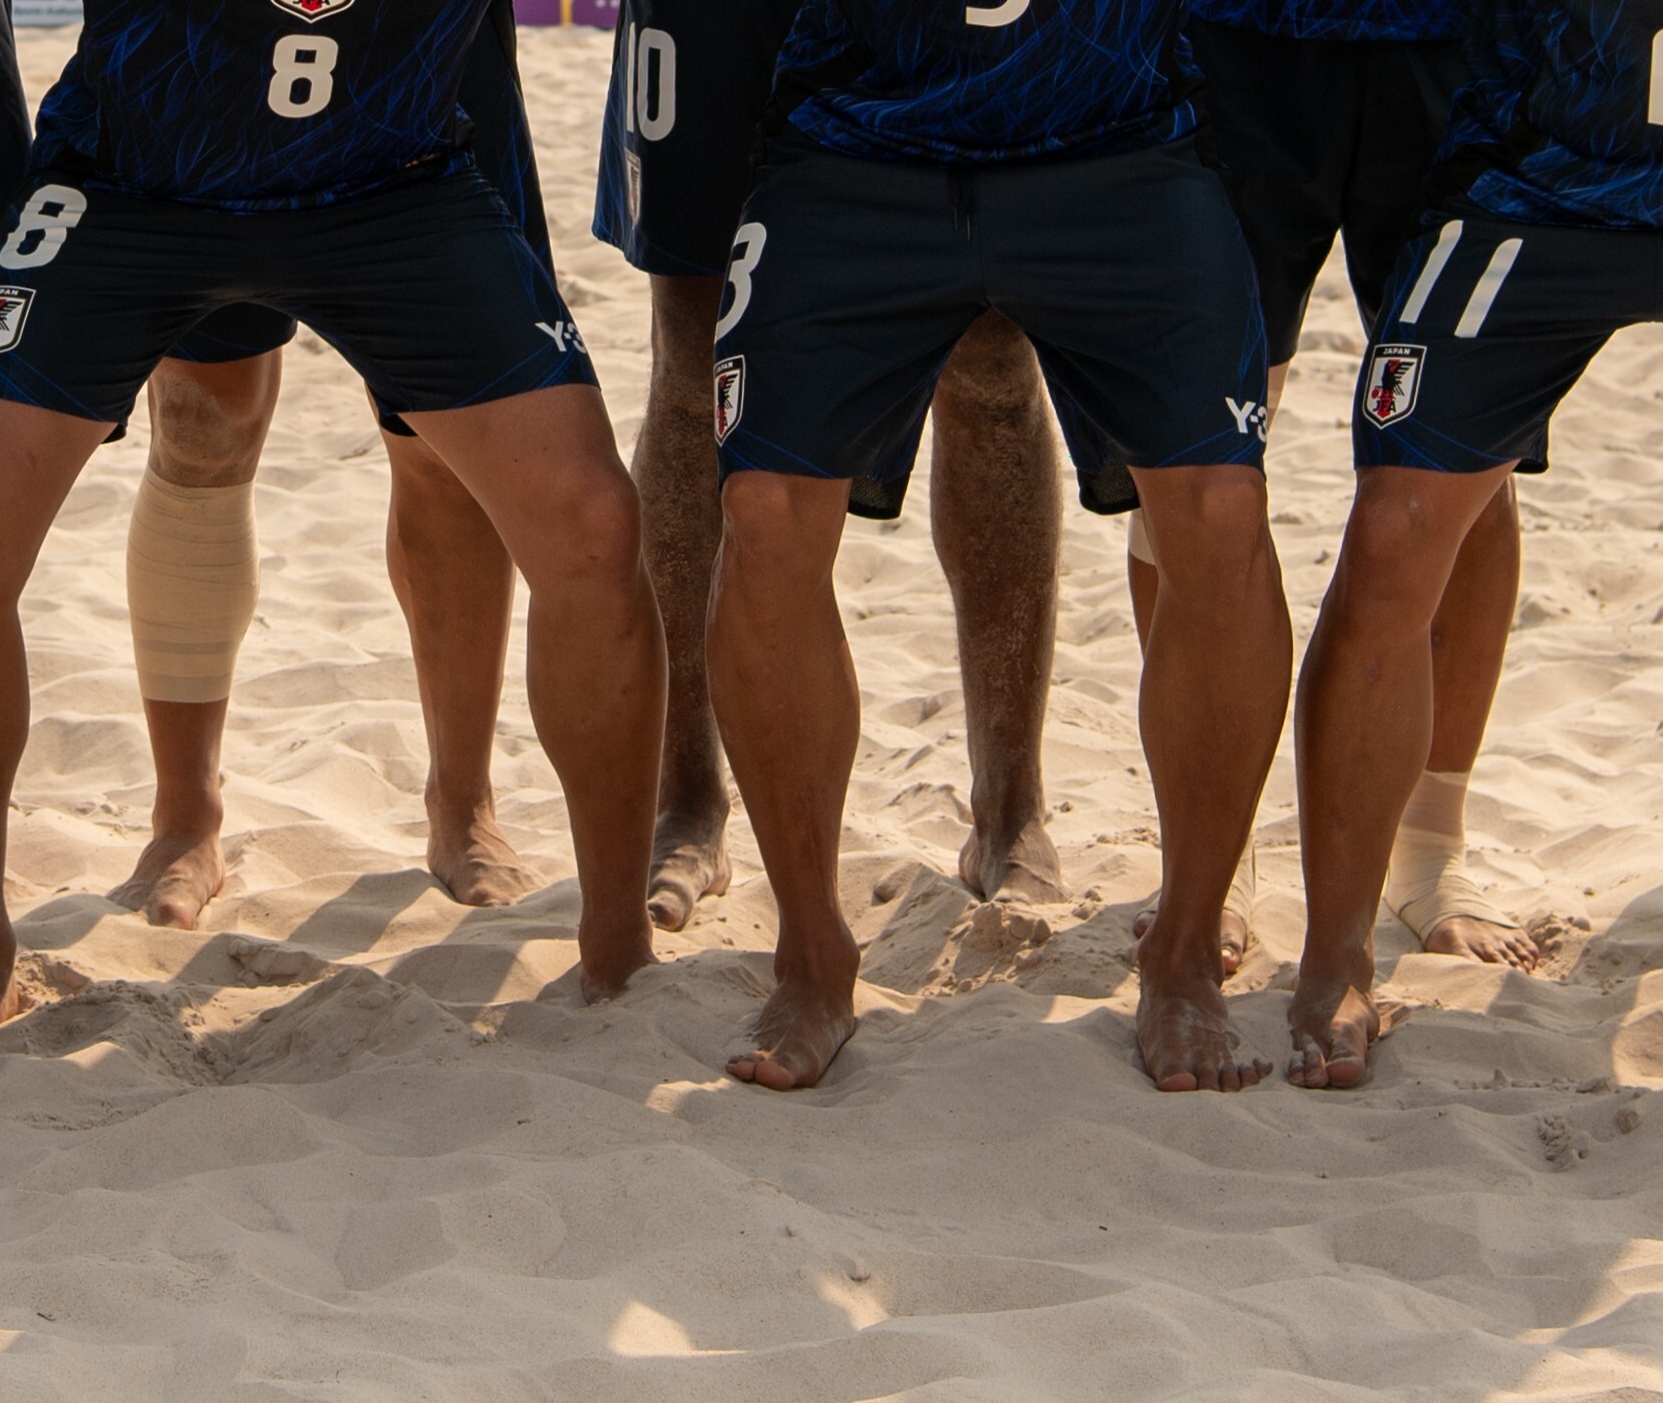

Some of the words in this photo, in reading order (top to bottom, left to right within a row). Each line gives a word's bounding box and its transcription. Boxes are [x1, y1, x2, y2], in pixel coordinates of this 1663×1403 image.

[267, 35, 338, 119] 8
[627, 22, 676, 142] 10
[1399, 220, 1523, 338] 11
[535, 320, 587, 354] Y-3
[1225, 398, 1267, 442] Y-3
